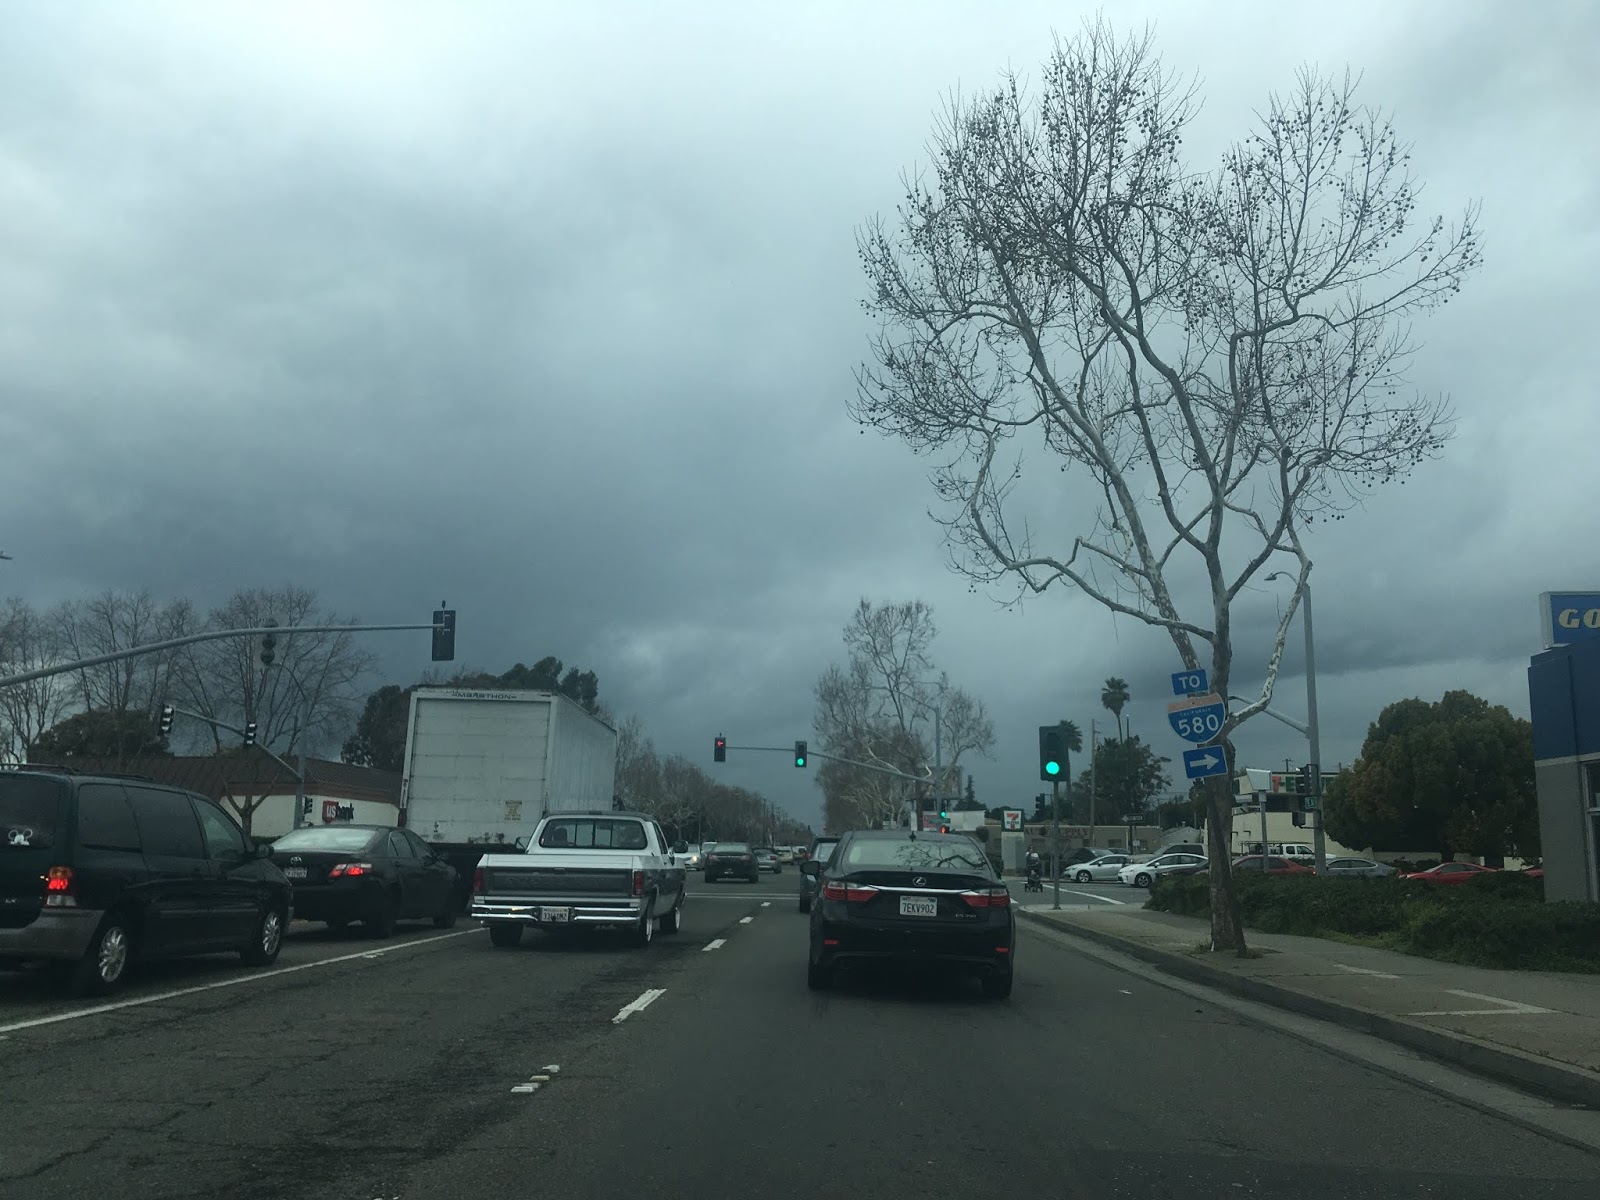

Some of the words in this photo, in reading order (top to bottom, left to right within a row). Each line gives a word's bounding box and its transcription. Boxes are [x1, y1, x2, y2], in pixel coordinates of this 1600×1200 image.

[1178, 675, 1201, 690] TO
[456, 692, 512, 700] MARATHON
[1178, 714, 1219, 737] 580
[902, 902, 935, 914] 7EKV902
